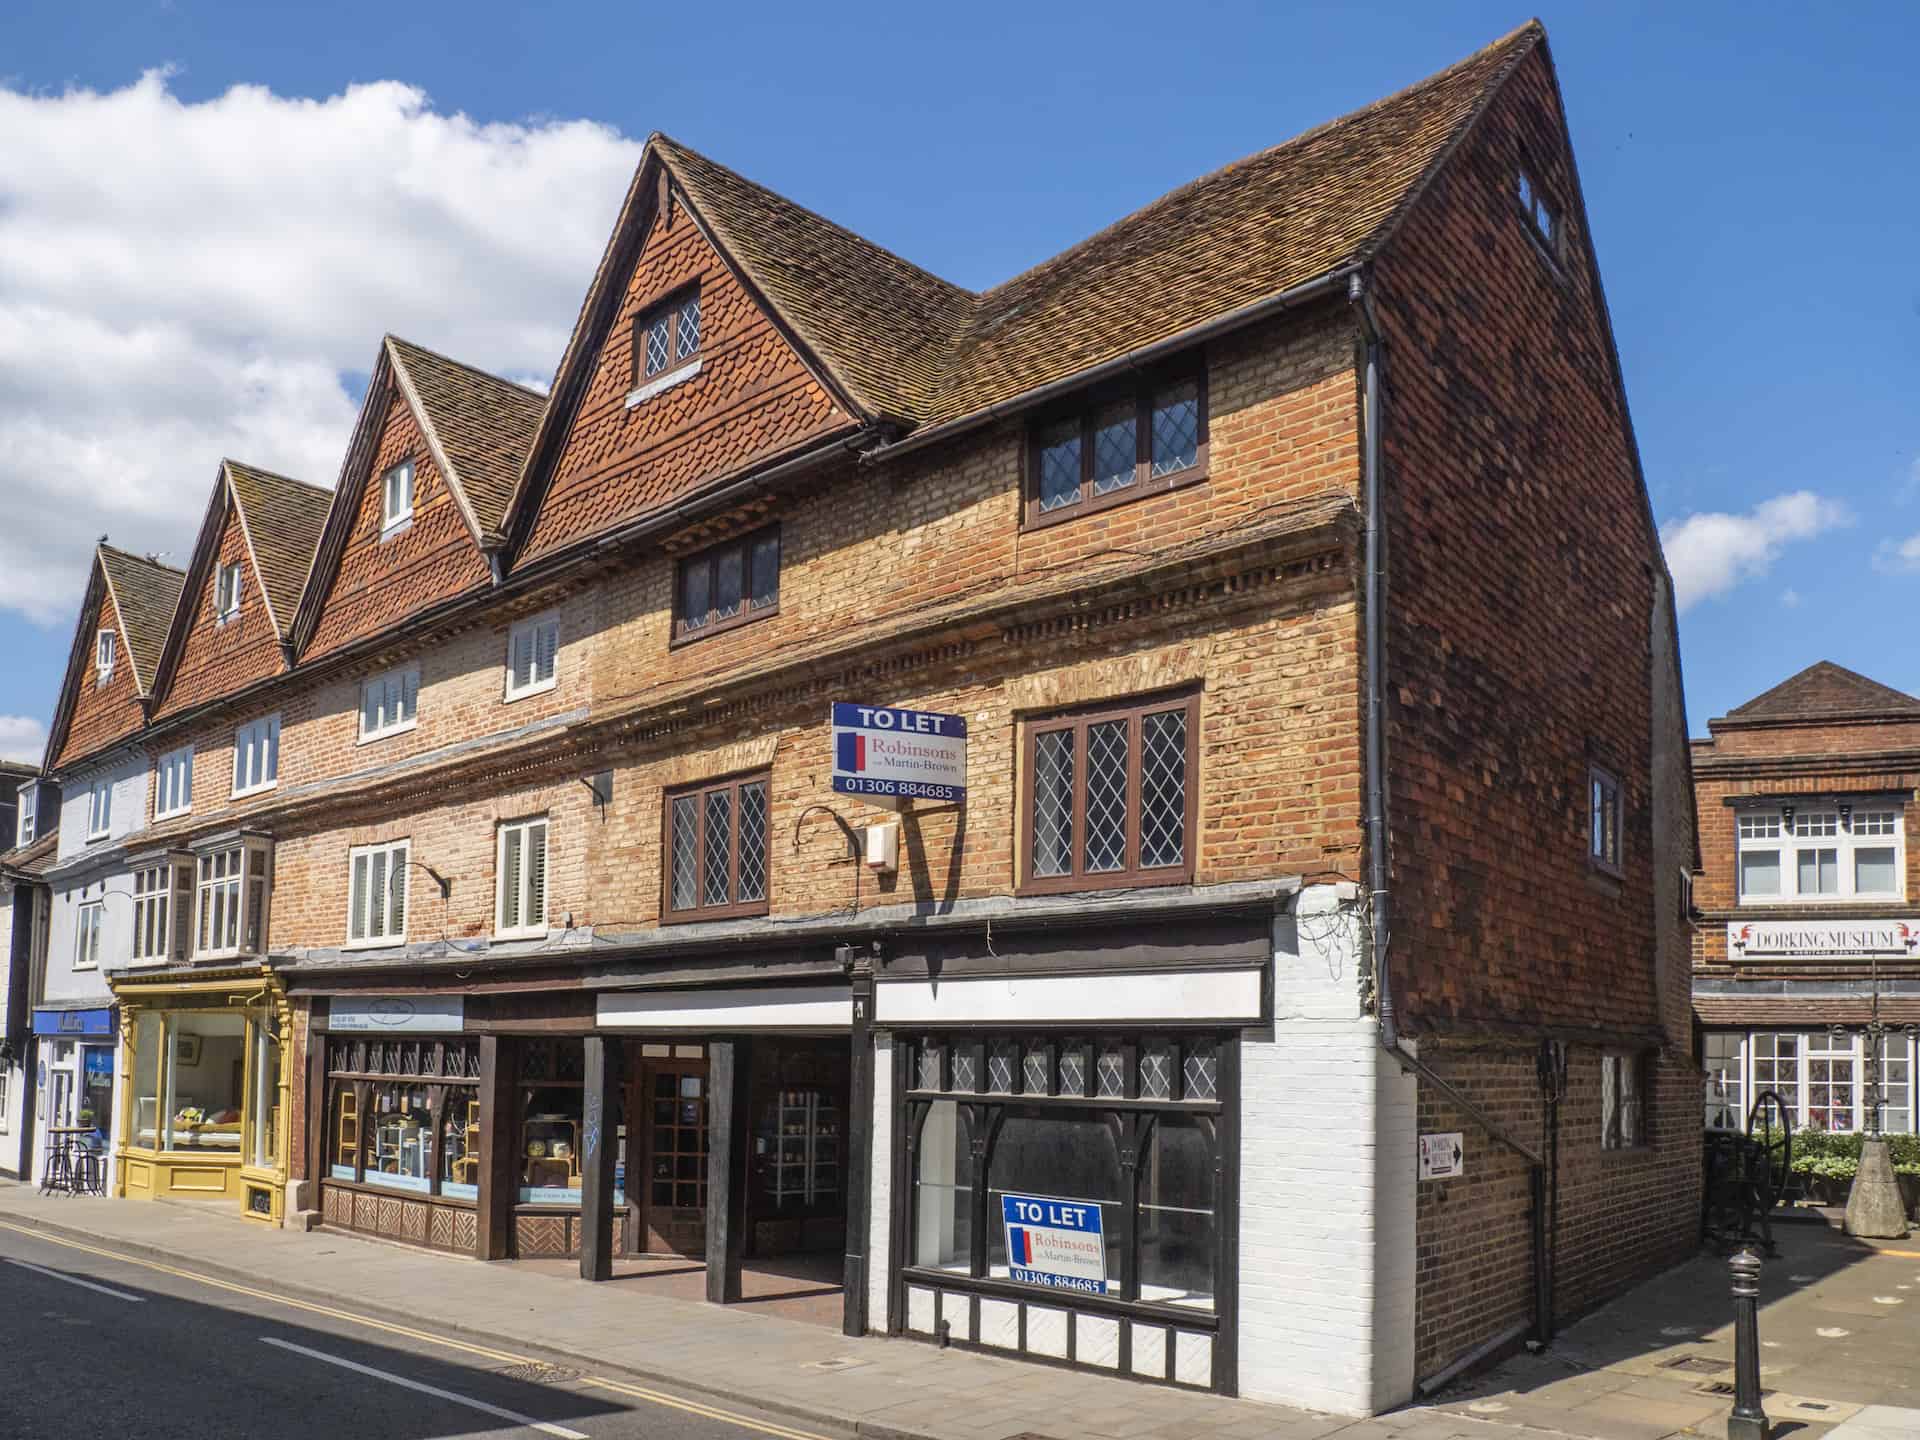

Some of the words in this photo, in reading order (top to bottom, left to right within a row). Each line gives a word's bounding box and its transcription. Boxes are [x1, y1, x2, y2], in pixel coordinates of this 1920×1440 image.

[857, 708, 895, 729] TO
[901, 713, 945, 734] LET
[872, 738, 957, 760] Robinsons
[884, 756, 957, 773] Martin-Brown
[846, 778, 895, 794] 01306
[898, 782, 953, 799] 884685
[1756, 932, 1824, 948] DORKING
[1829, 930, 1894, 947] MUSEUM
[1015, 1202, 1043, 1222] TO
[1049, 1205, 1087, 1227] LET
[1035, 1232, 1099, 1253] Robinsons
[1015, 1270, 1051, 1286] 01306
[1054, 1276, 1100, 1293] 884685
